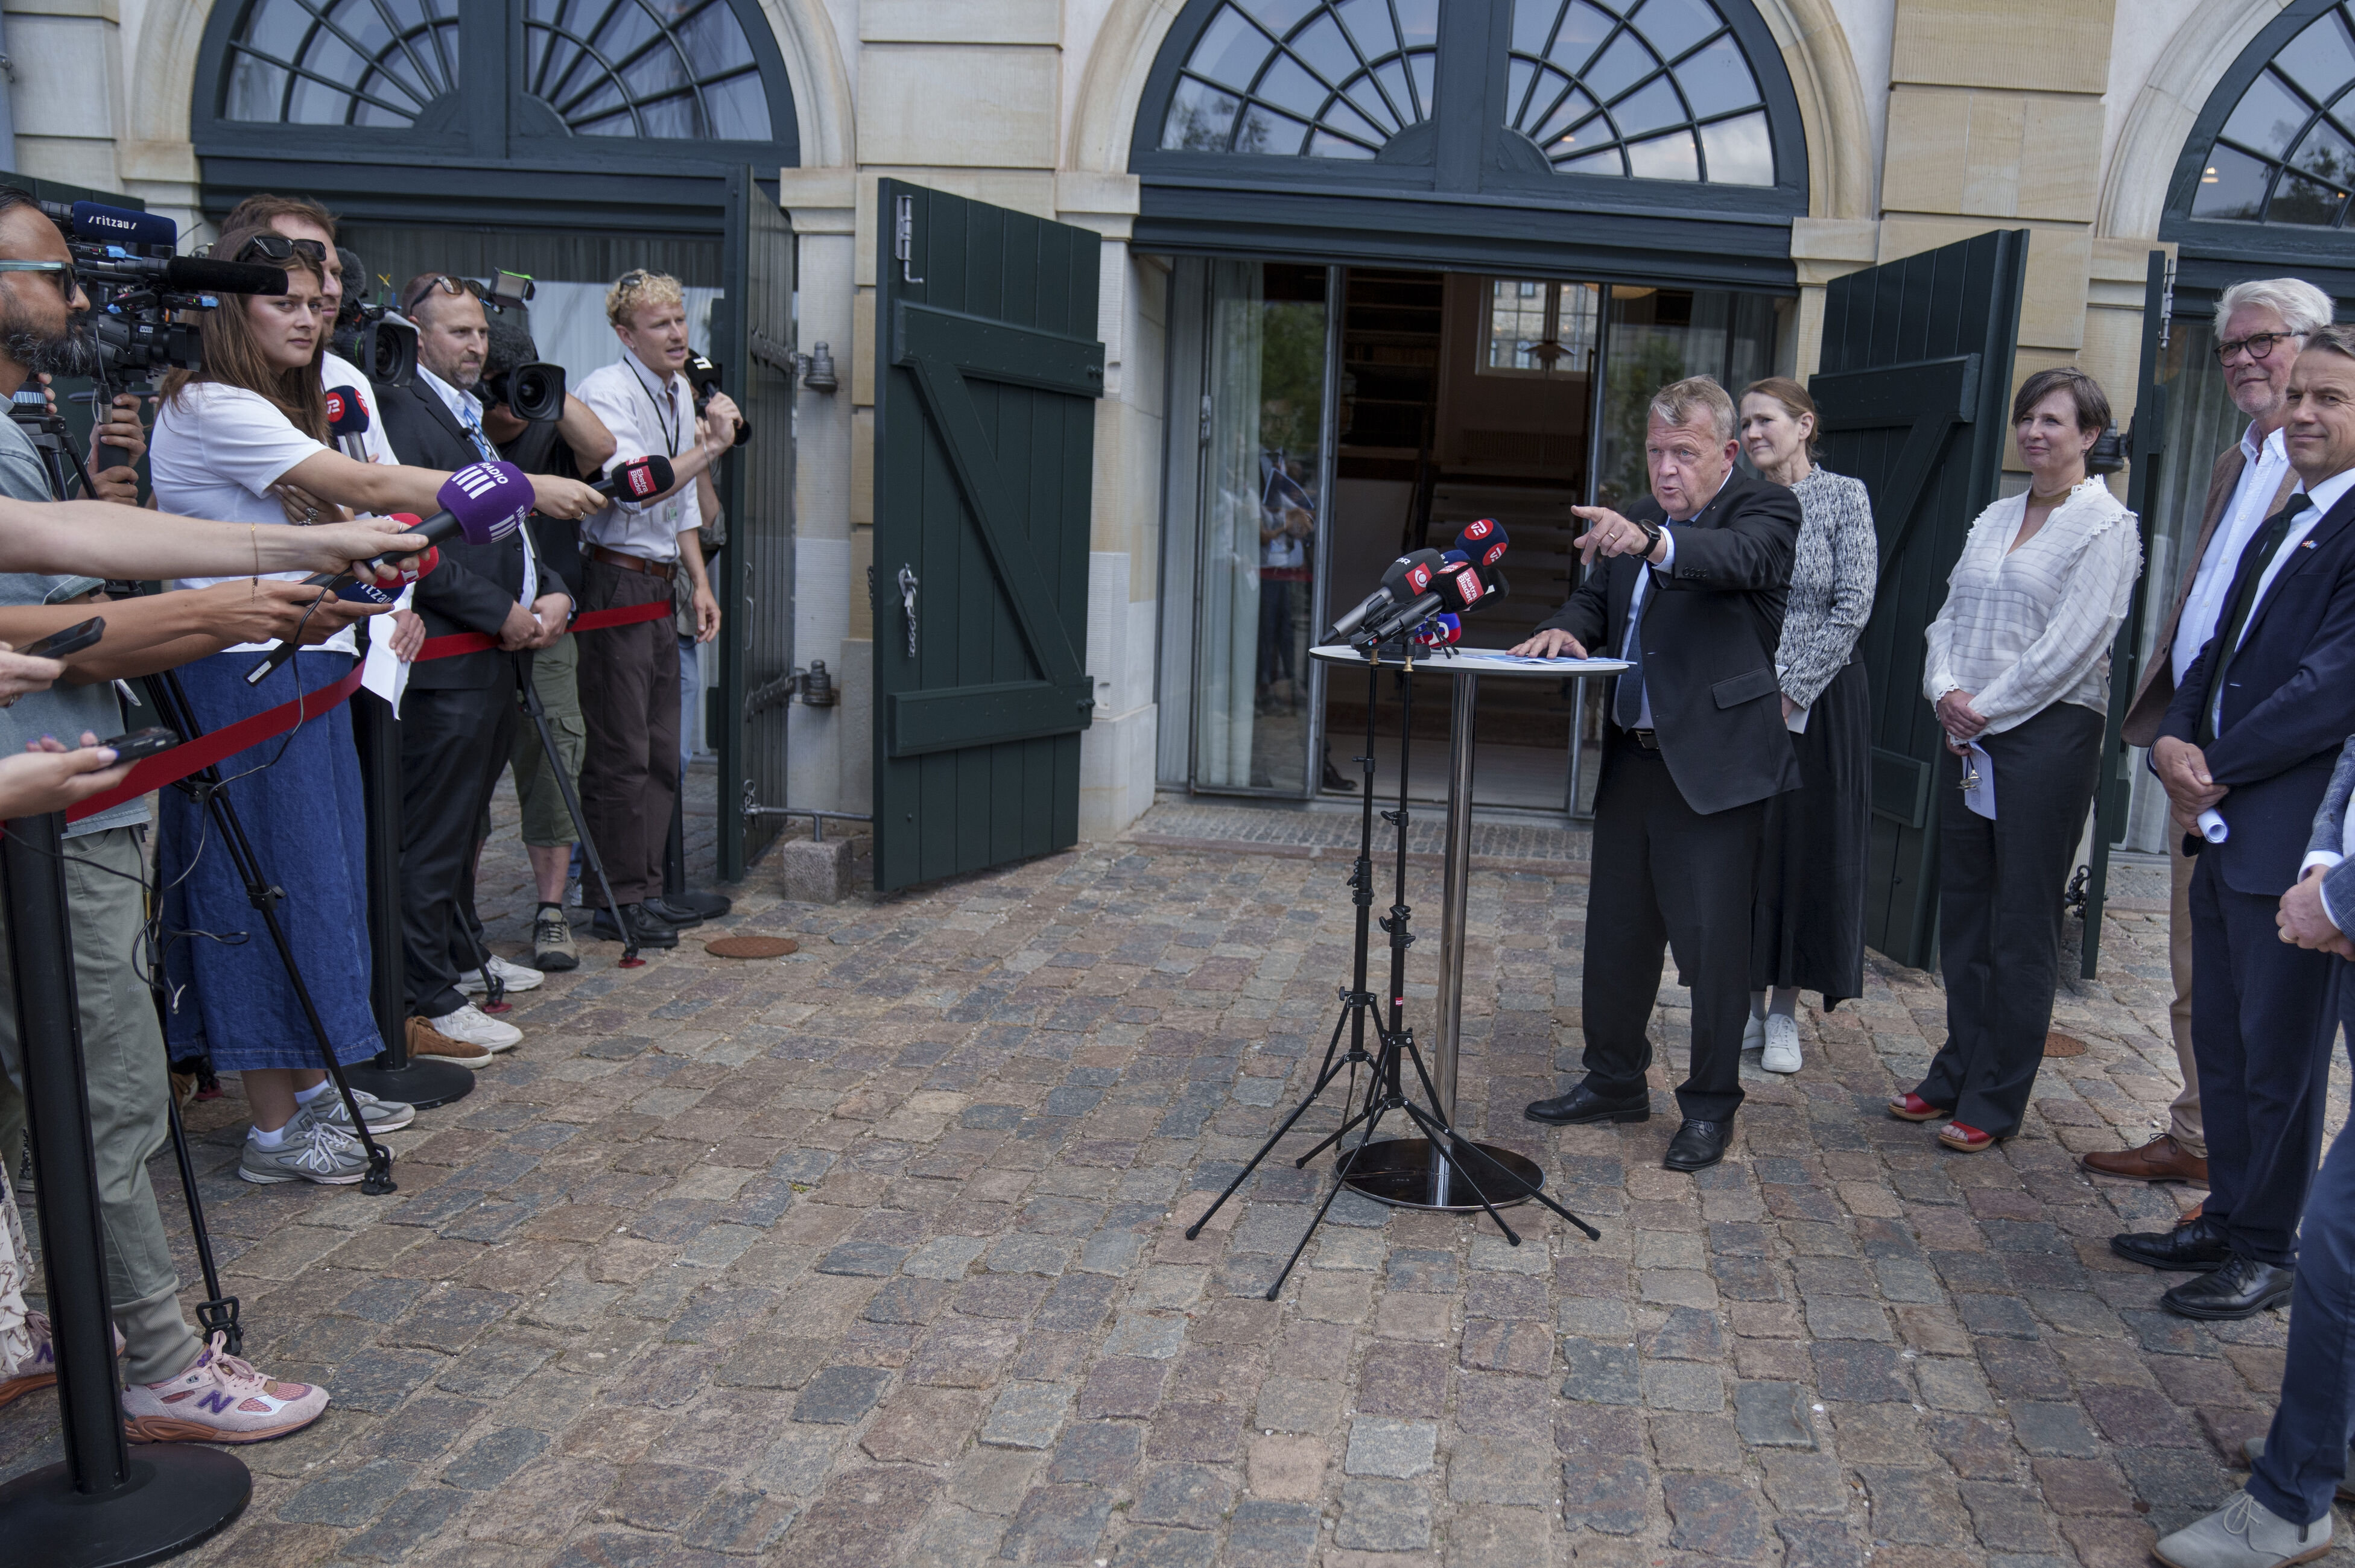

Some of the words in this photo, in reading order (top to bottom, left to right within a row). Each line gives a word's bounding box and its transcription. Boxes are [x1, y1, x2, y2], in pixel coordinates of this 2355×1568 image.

[478, 462, 509, 484] RADIO
[630, 470, 644, 495] Bladet
[636, 468, 648, 493] Ekstra
[1456, 575, 1472, 602] Bladet
[1463, 572, 1477, 599] Ekstra
[195, 1389, 235, 1415] N
